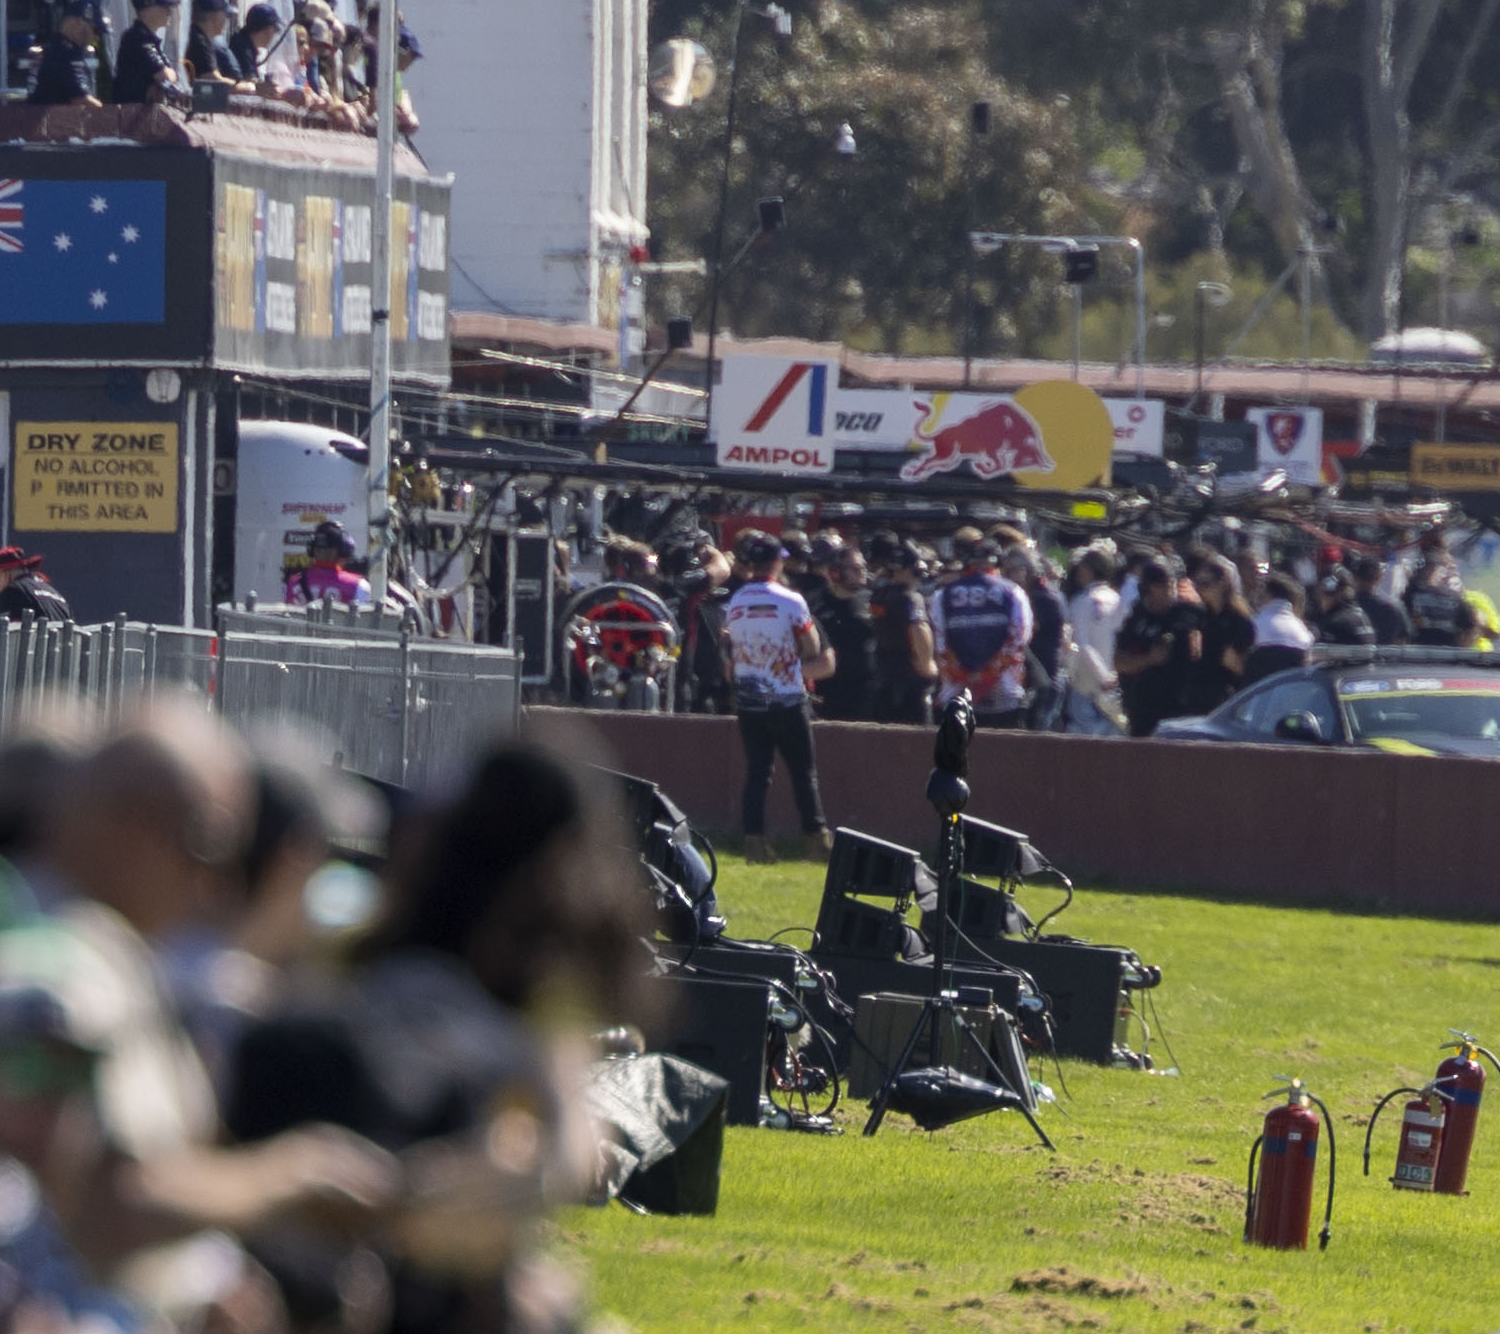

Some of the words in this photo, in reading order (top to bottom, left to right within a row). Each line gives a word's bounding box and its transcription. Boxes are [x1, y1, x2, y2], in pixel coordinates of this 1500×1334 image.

[27, 433, 81, 451] DRY
[91, 433, 166, 452] ZONE
[723, 445, 827, 467] AMPOL
[34, 458, 64, 475] NO
[68, 458, 160, 476] ALCOHOL
[30, 479, 140, 498] PRMITTED
[144, 481, 164, 499] IN
[47, 504, 90, 520] THIS
[94, 504, 149, 520] AREA
